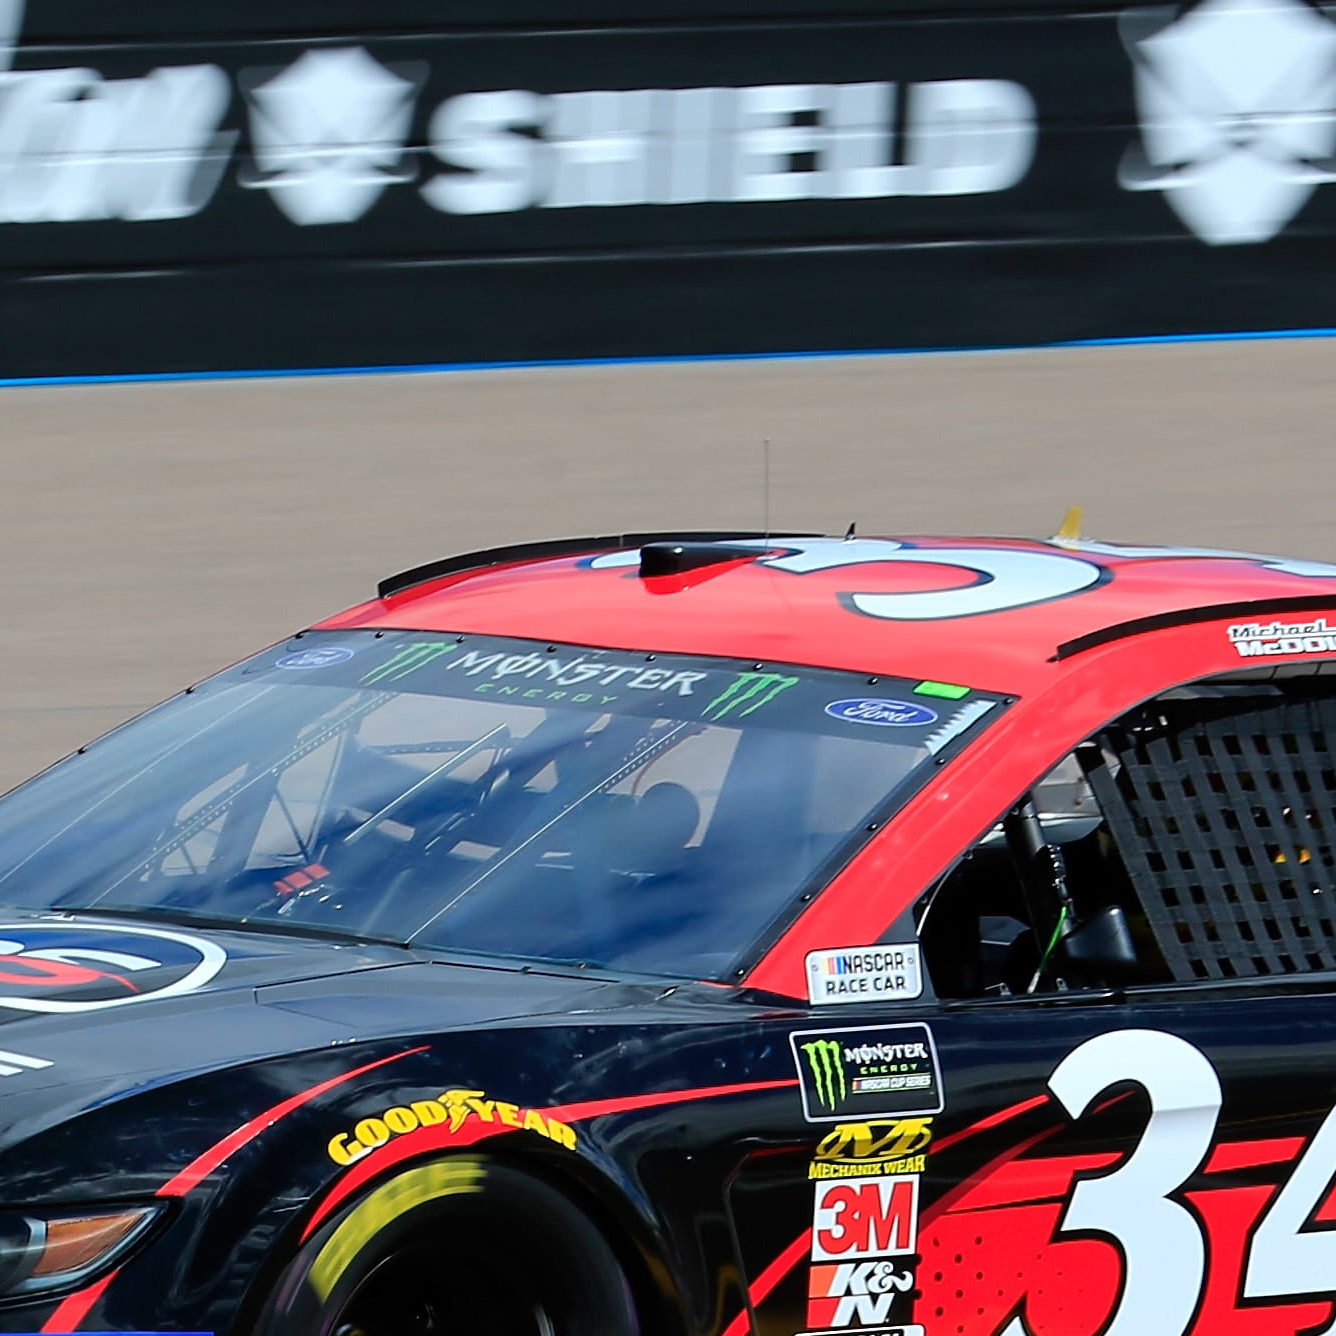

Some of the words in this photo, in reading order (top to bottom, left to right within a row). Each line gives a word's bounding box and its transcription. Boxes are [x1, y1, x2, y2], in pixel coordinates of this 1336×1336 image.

[1231, 620, 1325, 638] Michael
[843, 698, 921, 724] Ford
[844, 951, 905, 974] NASCAR
[826, 979, 866, 996] RACE
[874, 976, 906, 993] CAR
[327, 1092, 579, 1166] GOODYEAR
[808, 1161, 882, 1179] MECHANIX
[884, 1154, 925, 1174] WEAR
[818, 1181, 914, 1255] 3M
